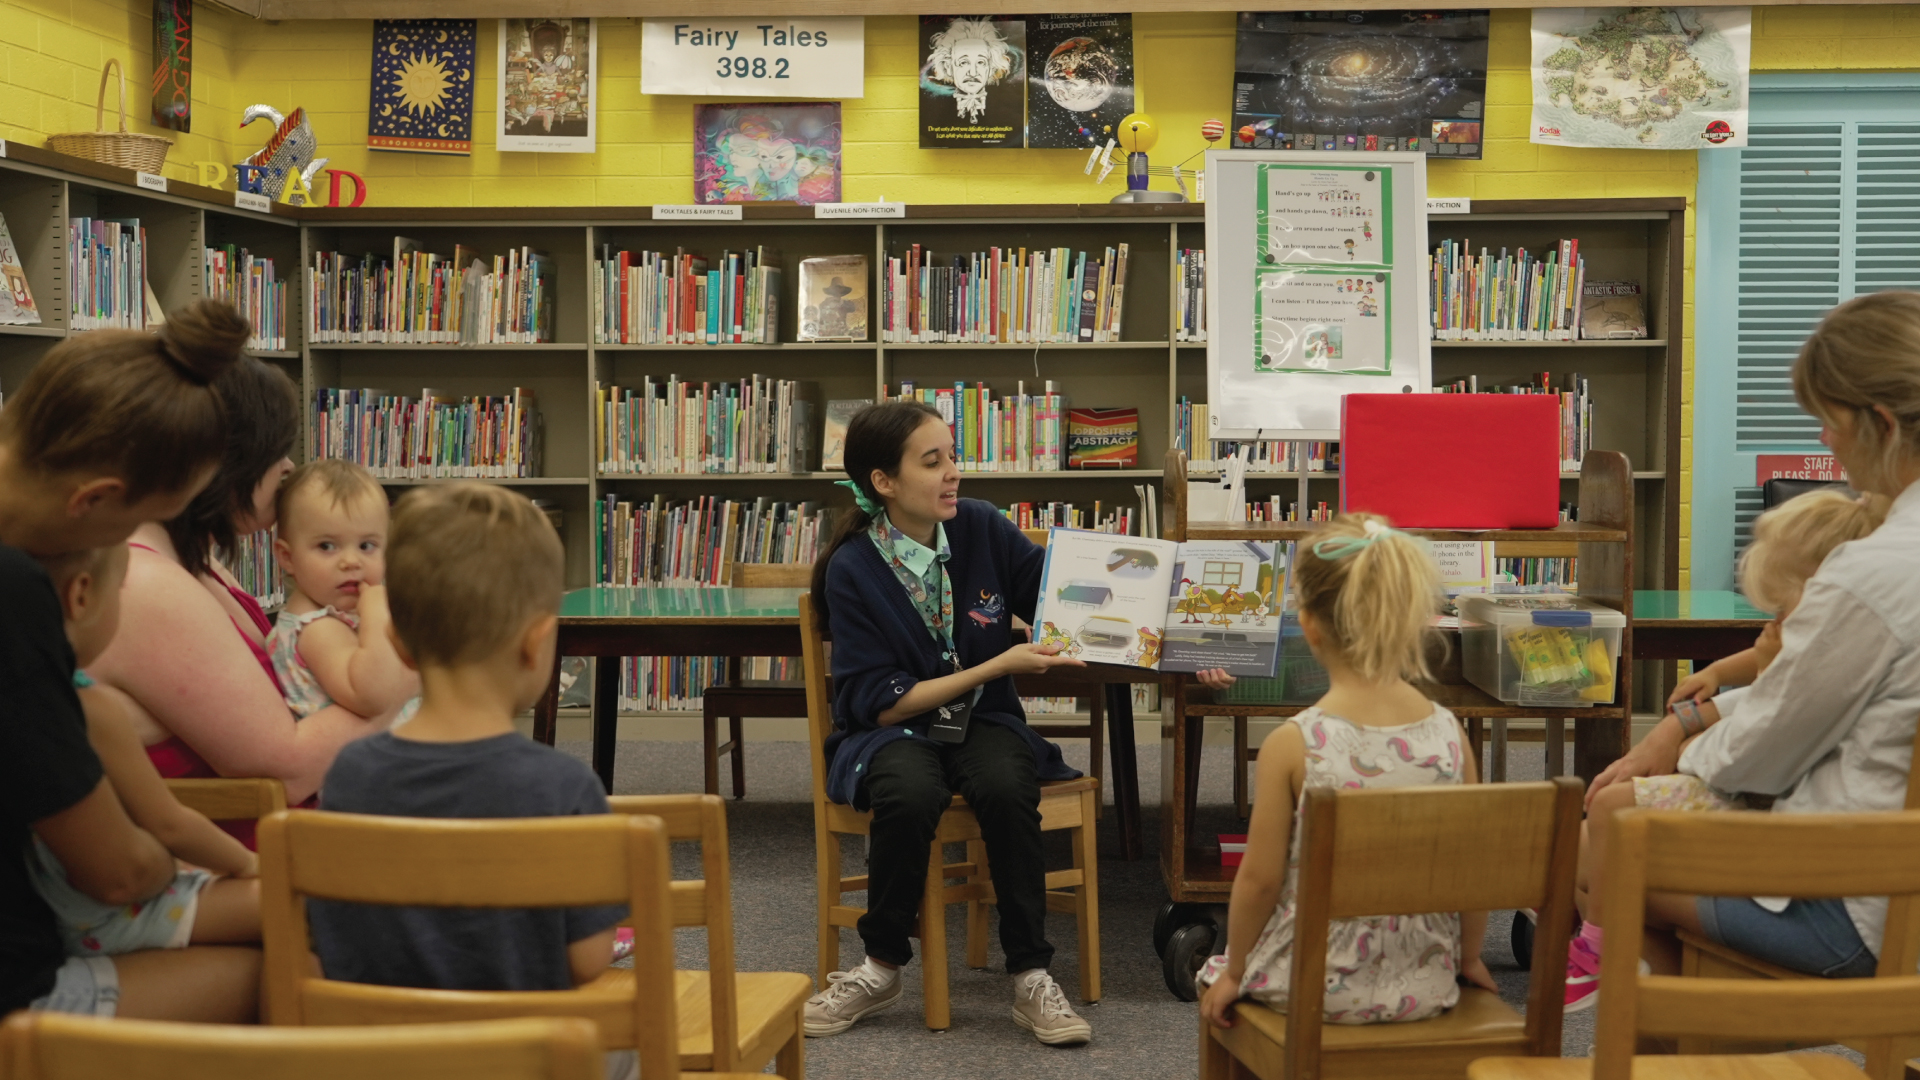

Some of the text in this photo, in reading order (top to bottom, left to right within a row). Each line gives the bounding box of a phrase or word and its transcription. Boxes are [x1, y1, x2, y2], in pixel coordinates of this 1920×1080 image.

[1040, 17, 1119, 30] for journeys of the mind.
[674, 24, 828, 50] Fairy Tales
[716, 56, 790, 79] 398.2
[172, 68, 190, 117] DO
[1539, 126, 1561, 135] Kodak
[194, 160, 367, 208] READ
[699, 208, 716, 216] FAIRY
[717, 208, 734, 216] TALES
[1190, 252, 1198, 280] SPACE
[1584, 285, 1636, 295] ANTASTIC FOSSILS
[1074, 427, 1133, 436] OPPOSITES
[1074, 437, 1133, 445] ABSTRACT
[1803, 457, 1834, 470] STAFF
[1772, 470, 1811, 480] PLEASE
[1818, 471, 1833, 480] DO
[1444, 542, 1461, 550] using
[1438, 551, 1456, 559] phone
[1439, 560, 1461, 568] library.
